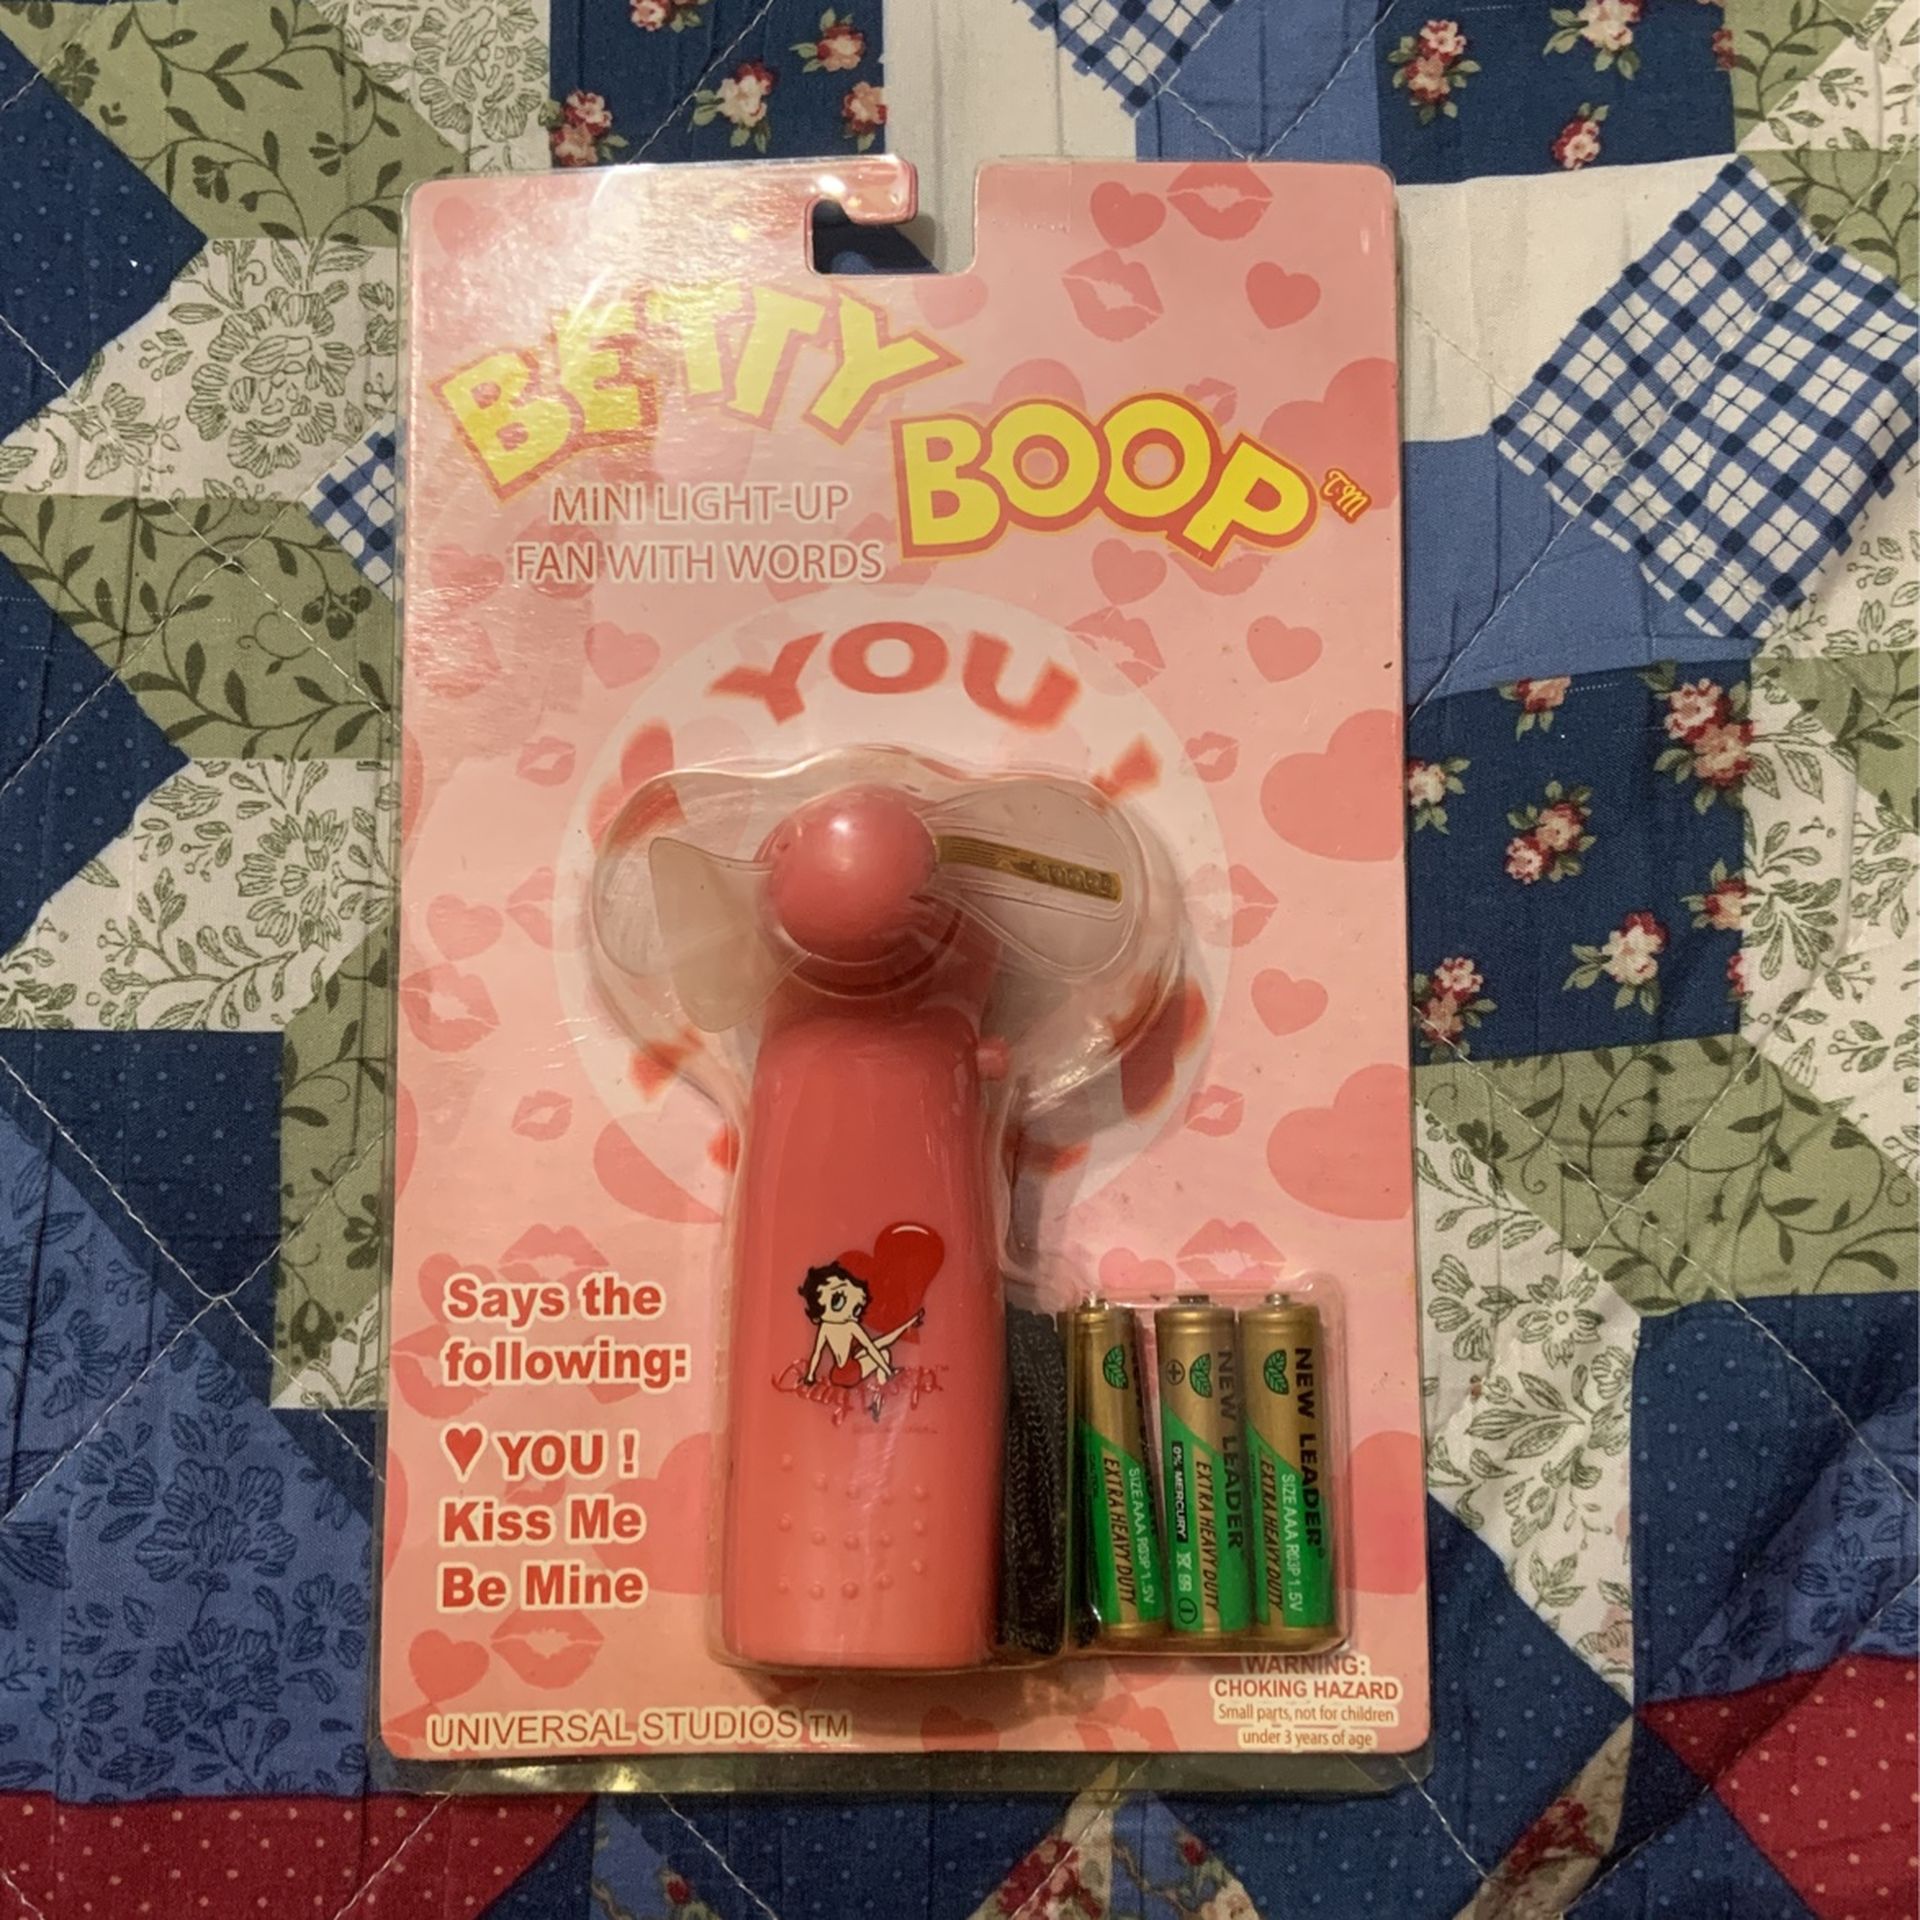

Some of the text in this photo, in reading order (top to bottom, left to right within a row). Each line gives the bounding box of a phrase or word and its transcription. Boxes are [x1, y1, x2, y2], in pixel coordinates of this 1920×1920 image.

[430, 281, 962, 501] BETTY
[891, 393, 1317, 569] BOOP
[553, 485, 849, 521] MINI LIGHT-UP
[516, 543, 882, 580] FAN WITH WORDS
[704, 621, 1080, 731] YOU
[448, 1276, 662, 1328] Says the
[446, 1340, 687, 1389] following:
[1295, 1347, 1316, 1419] NEW
[497, 1434, 604, 1476] YOU
[1218, 1351, 1244, 1550] NEW LEADER
[1129, 1466, 1143, 1497] SIZE
[1282, 1473, 1298, 1505] SIZE
[444, 1499, 642, 1542] Kiss Me
[1132, 1500, 1147, 1535] AAA
[1174, 1469, 1187, 1540] MERCURY
[1283, 1506, 1299, 1541] AAA
[1104, 1456, 1137, 1607] EXTRA HEAVY DUTY
[1196, 1460, 1220, 1611] EXTRA HEAVY DUTY
[1260, 1459, 1283, 1611] EXTRA HEAVY DUTY
[442, 1563, 643, 1608] Be Mine
[1248, 1655, 1367, 1676] WARNING:
[1214, 1678, 1398, 1700] CHOKING HAZARD
[431, 1711, 848, 1748] UNIVERSAL STUDIOS TM
[1219, 1704, 1394, 1722] Small parts, not for children
[1243, 1730, 1373, 1749] under 3 years of age
